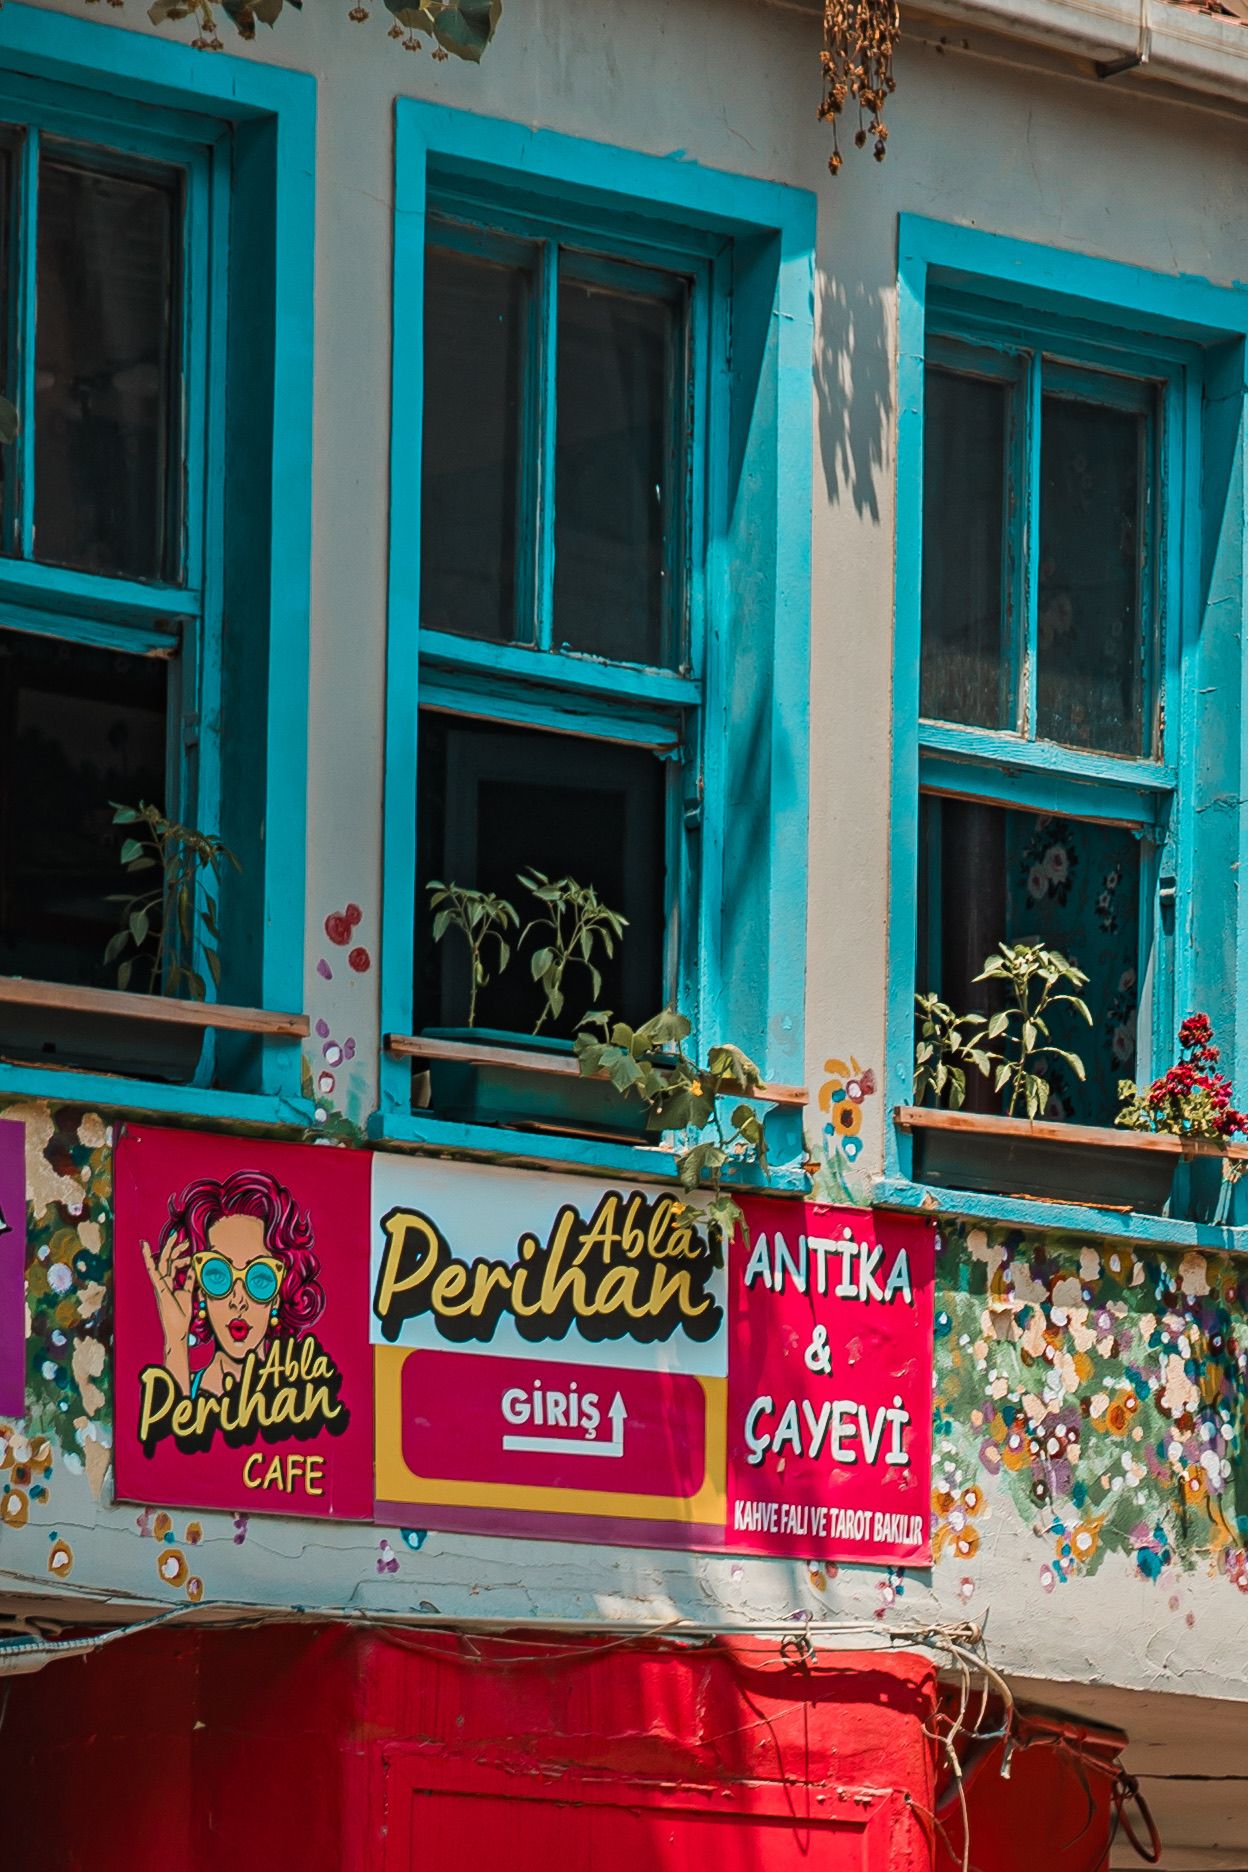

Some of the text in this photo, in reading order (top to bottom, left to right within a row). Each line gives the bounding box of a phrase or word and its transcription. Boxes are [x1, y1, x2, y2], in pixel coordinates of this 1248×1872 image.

[574, 1196, 703, 1265] Abla
[376, 1209, 713, 1319] Perihan
[744, 1226, 912, 1305] ANTİKA
[257, 1336, 335, 1393] Abla
[803, 1323, 832, 1376] &
[139, 1353, 343, 1442] Perihan
[501, 1378, 601, 1440] GİRİŞ
[744, 1395, 911, 1467] ÇAYEVİ
[242, 1452, 326, 1497] CAFE
[734, 1500, 923, 1545] KAHVE FALI VE TAROT BAKILIR
